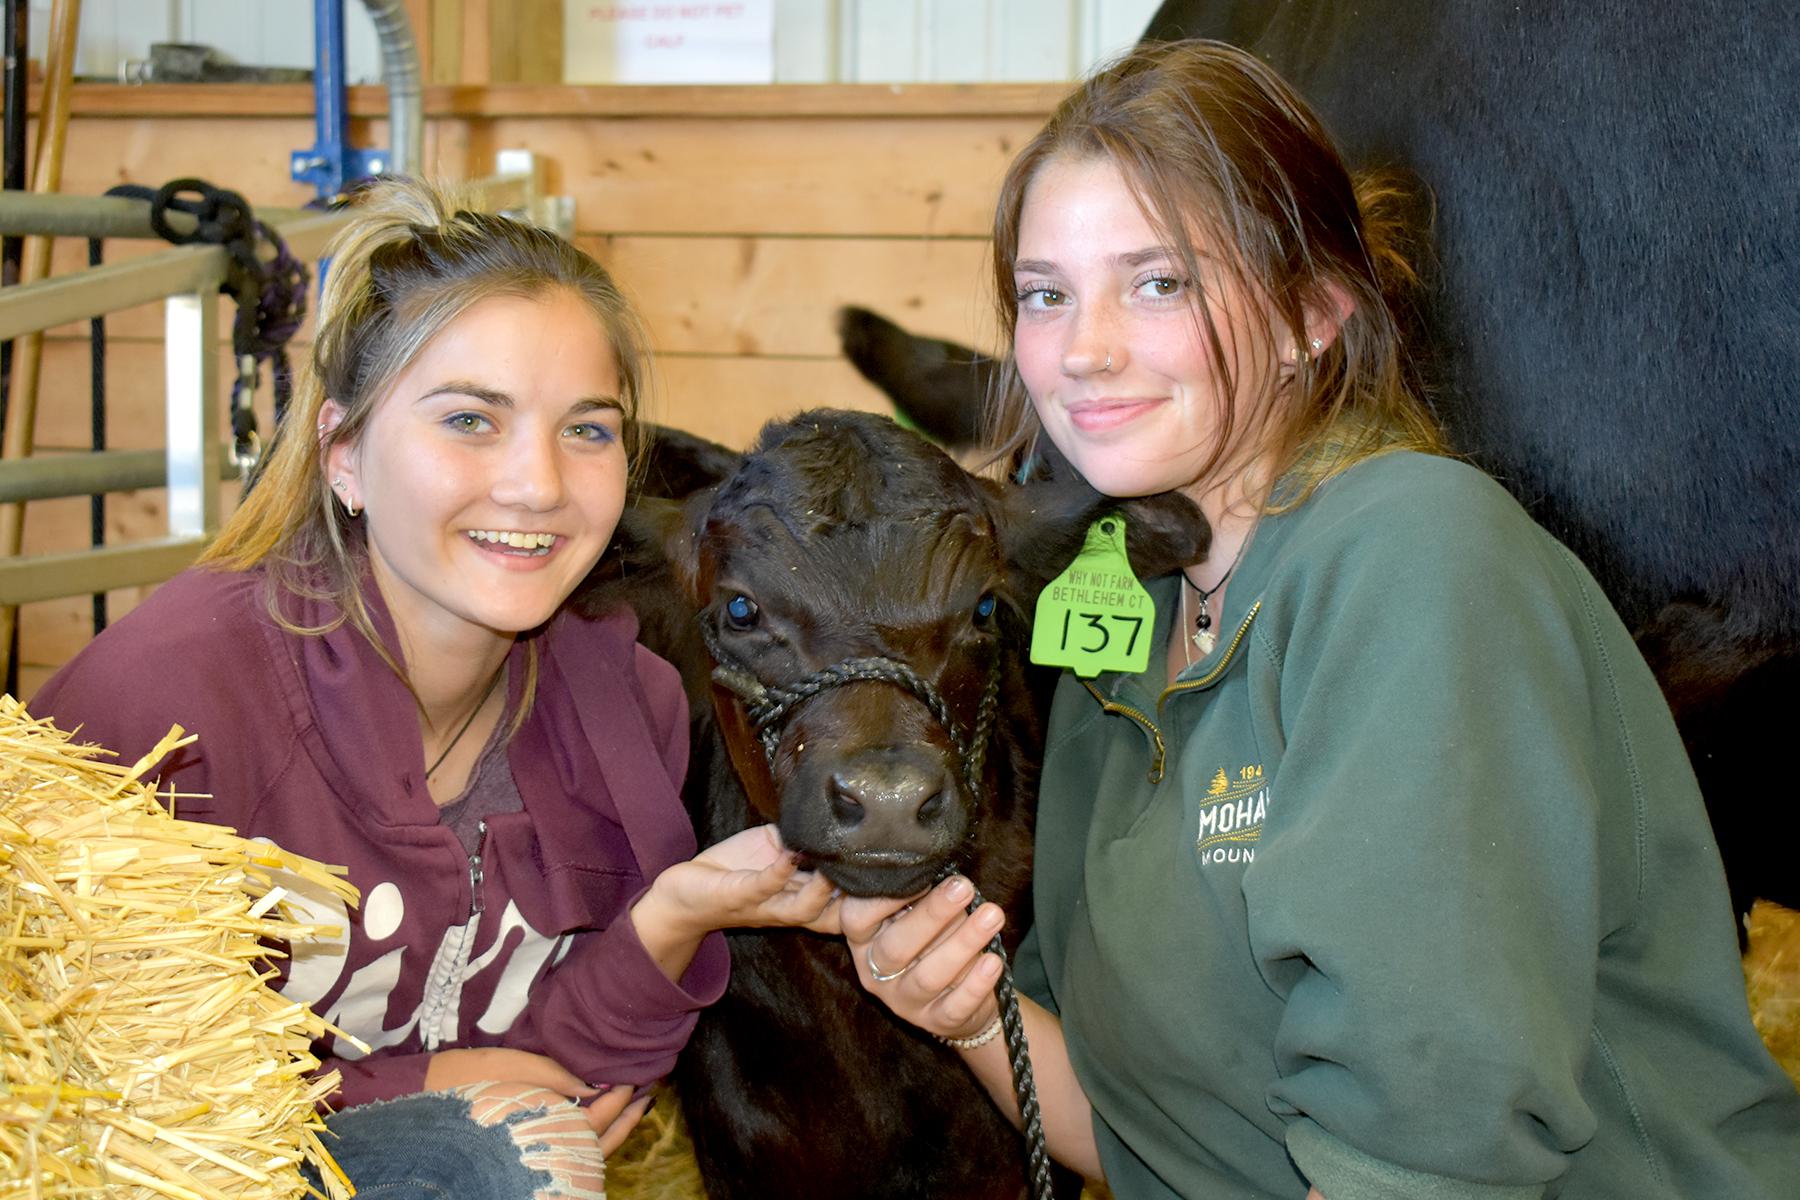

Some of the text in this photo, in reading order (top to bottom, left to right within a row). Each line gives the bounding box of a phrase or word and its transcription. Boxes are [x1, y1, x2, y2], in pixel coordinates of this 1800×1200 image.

[590, 5, 744, 19] PLEASE DO NOT PET
[1068, 570, 1134, 591] WHY NOT FARM
[1052, 586, 1145, 609] BETHLEHEM CT
[1060, 609, 1144, 657] 137
[1198, 786, 1270, 841] MOHA
